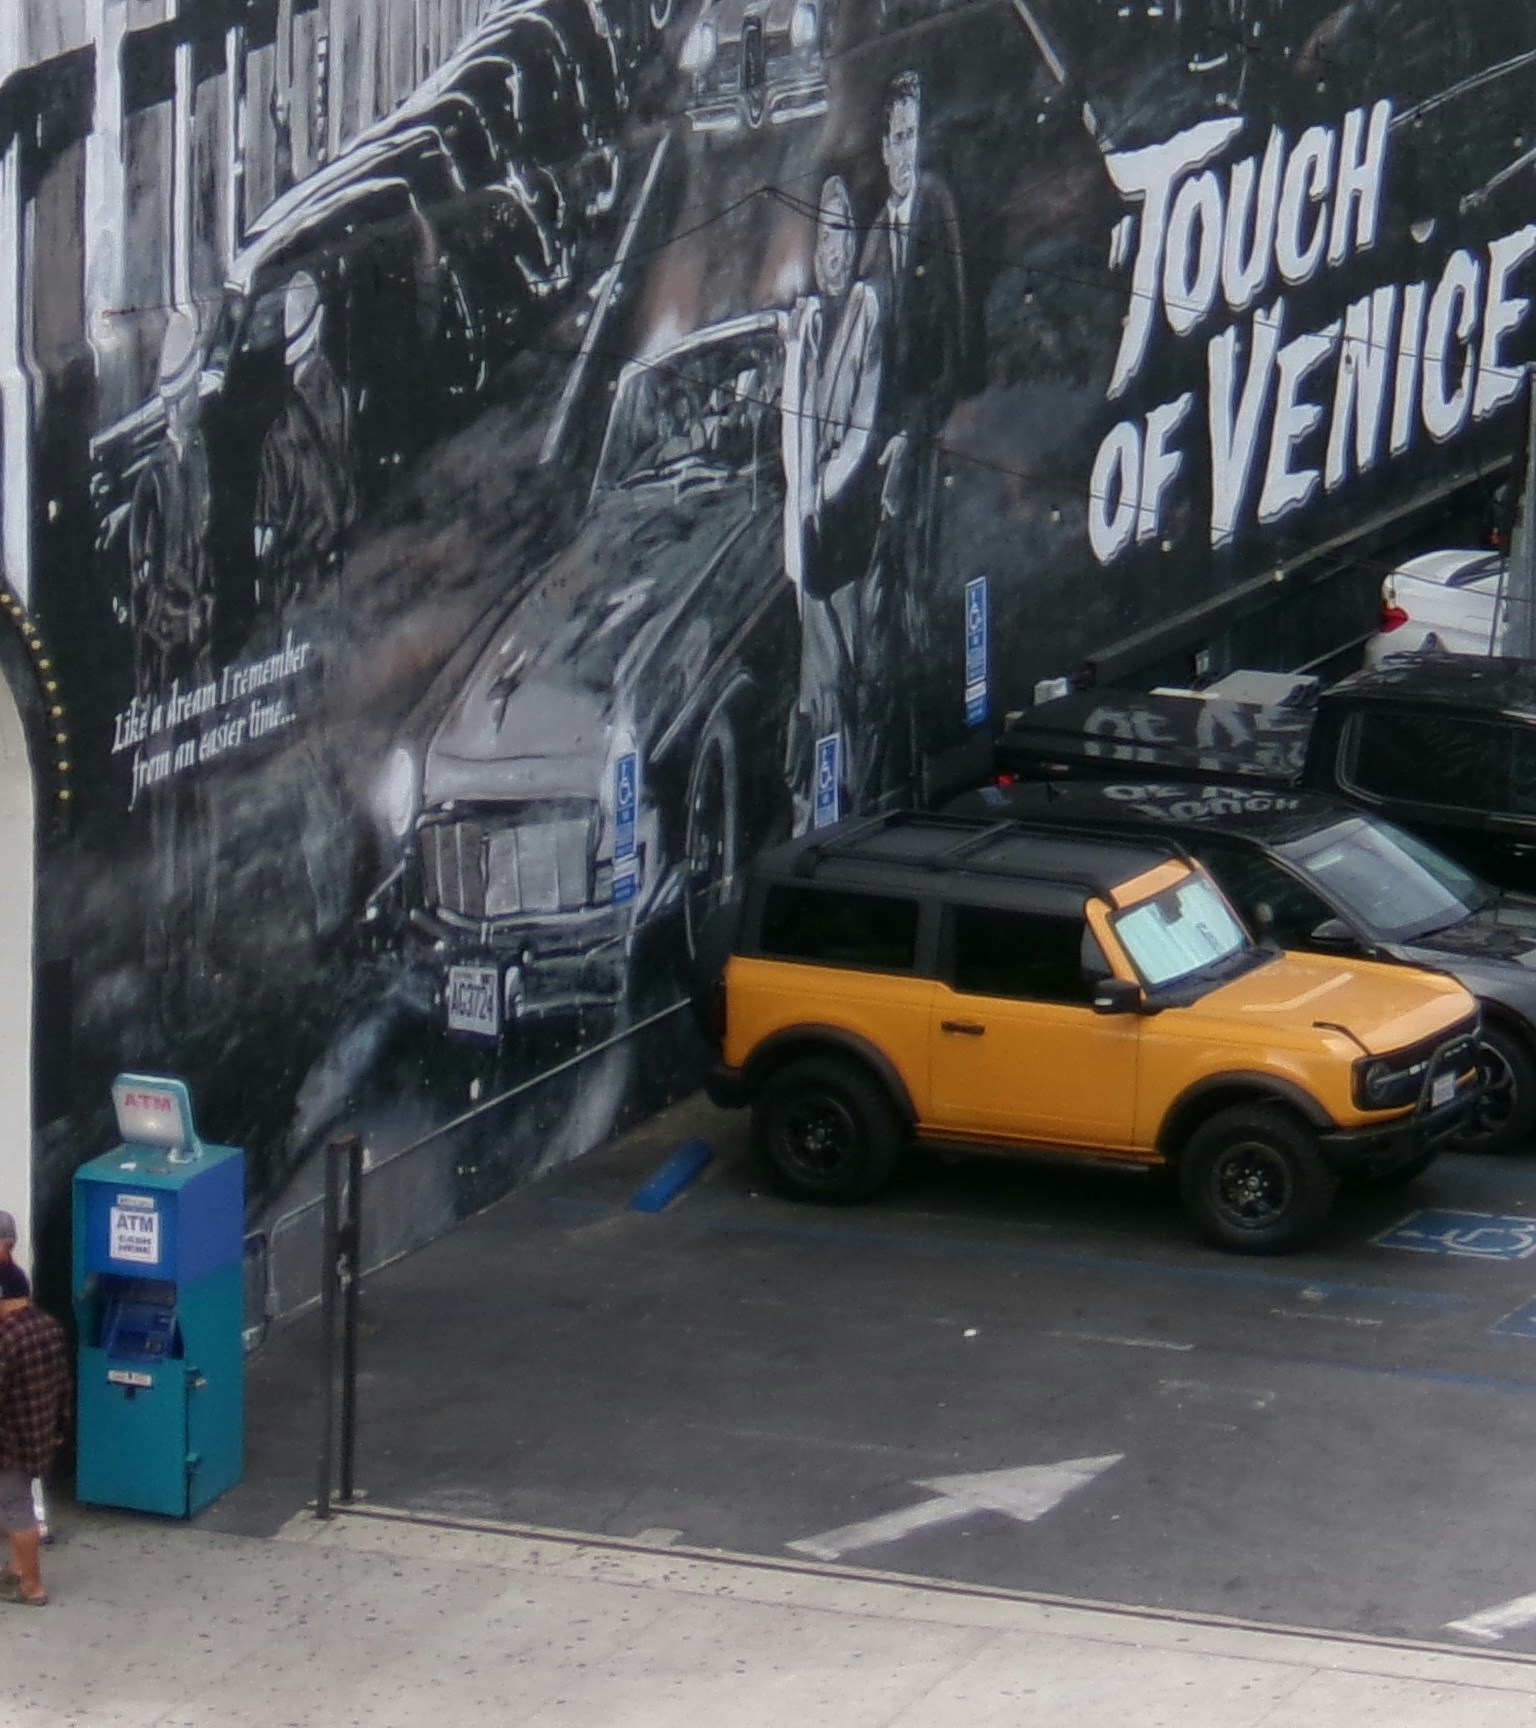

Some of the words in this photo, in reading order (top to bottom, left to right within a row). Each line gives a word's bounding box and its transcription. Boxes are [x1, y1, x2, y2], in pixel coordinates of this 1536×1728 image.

[1087, 390, 1193, 567] OF
[110, 695, 150, 755] Like
[150, 703, 164, 737] a
[165, 676, 217, 731] dream
[231, 628, 312, 700] remember
[126, 746, 173, 814] from
[173, 738, 196, 774] an
[198, 711, 248, 763] easier
[124, 1092, 172, 1113] ATM
[117, 1214, 154, 1233] ATM
